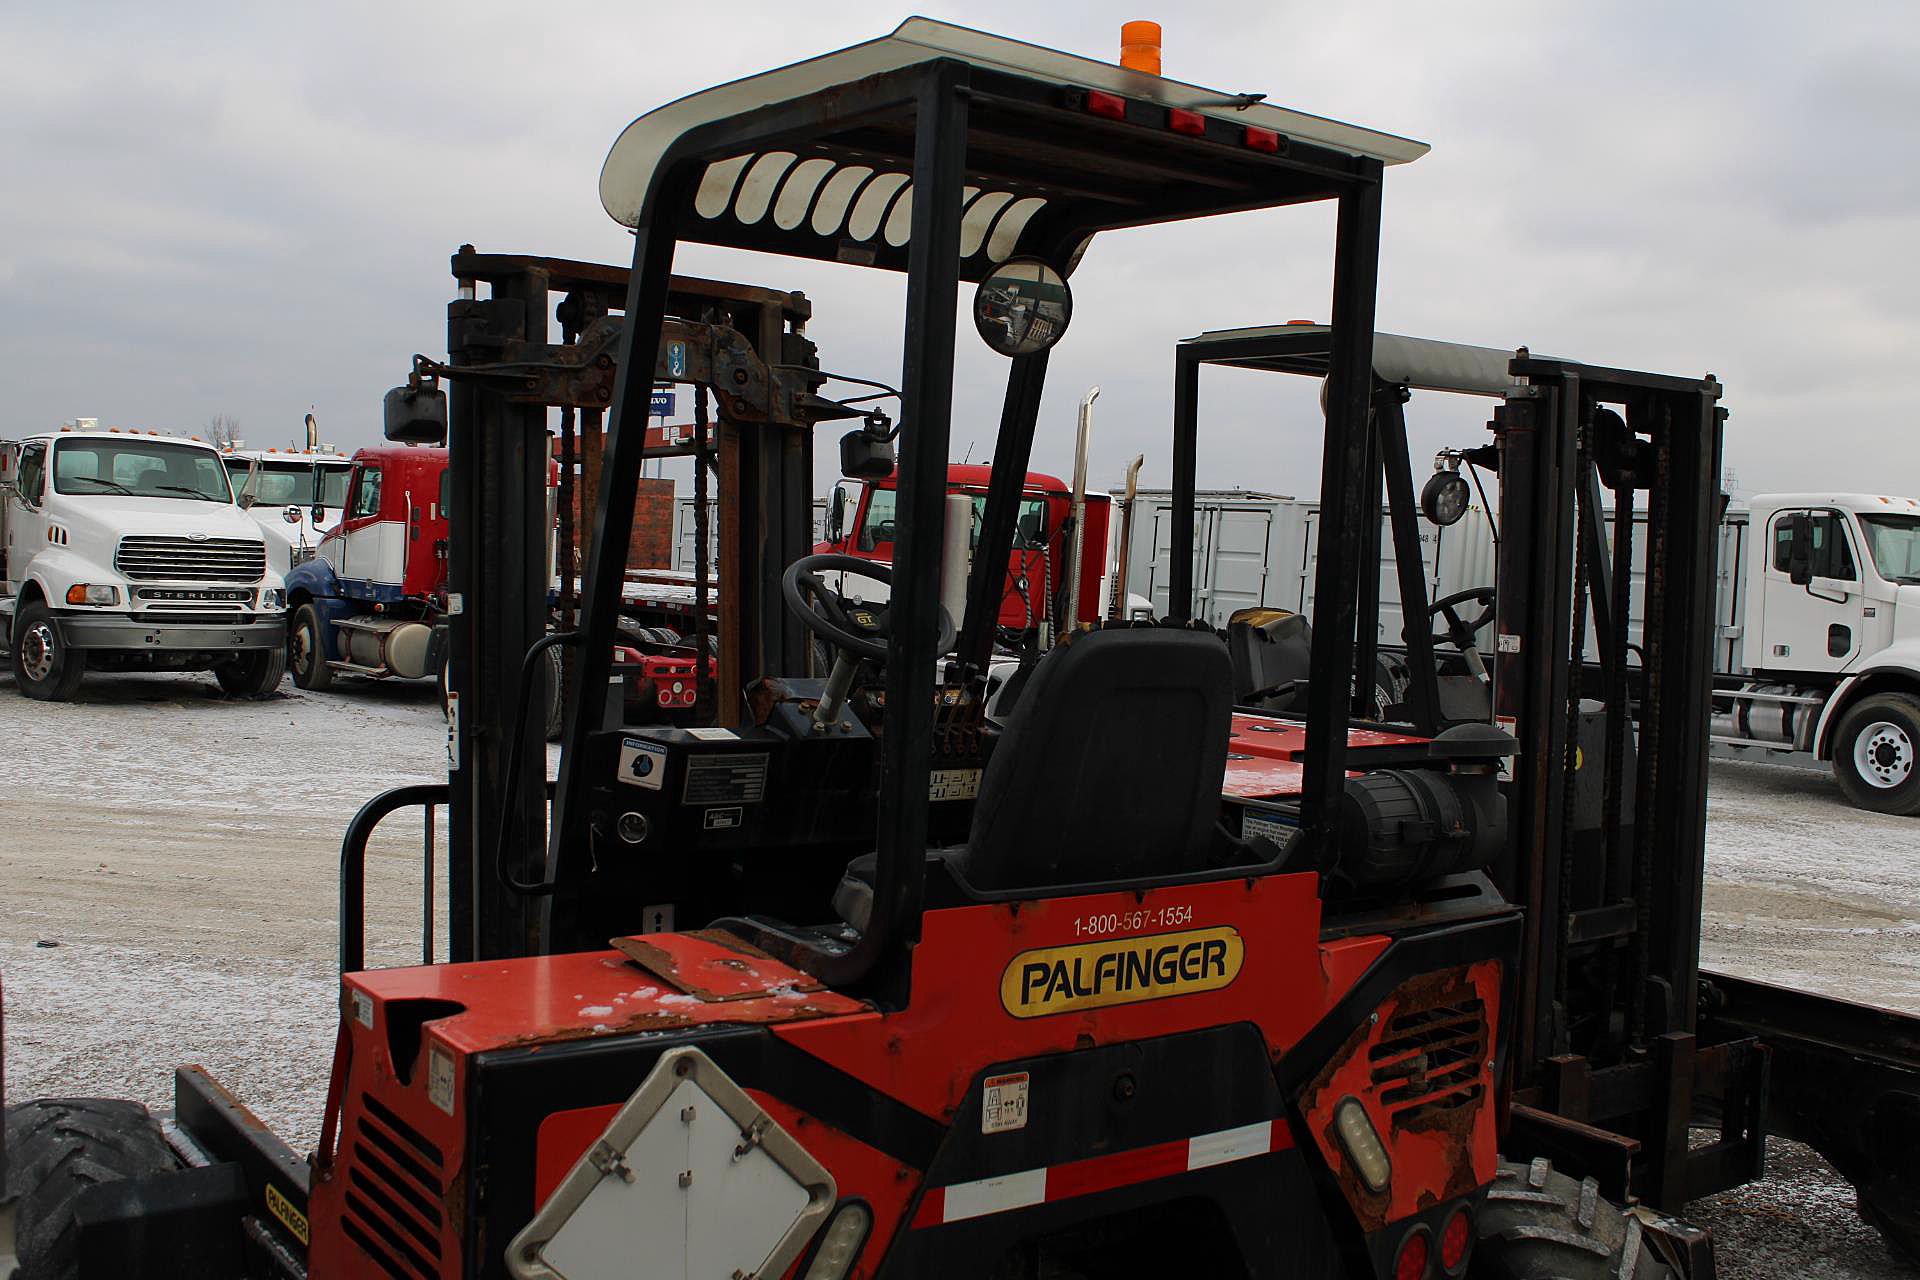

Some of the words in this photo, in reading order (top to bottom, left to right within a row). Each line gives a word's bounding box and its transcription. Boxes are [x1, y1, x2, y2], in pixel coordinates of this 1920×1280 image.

[153, 591, 238, 600] STERLING
[625, 739, 667, 755] INFORMATION
[1073, 905, 1193, 937] 1-800-567-1554
[1021, 939, 1227, 1005] PALFINGER
